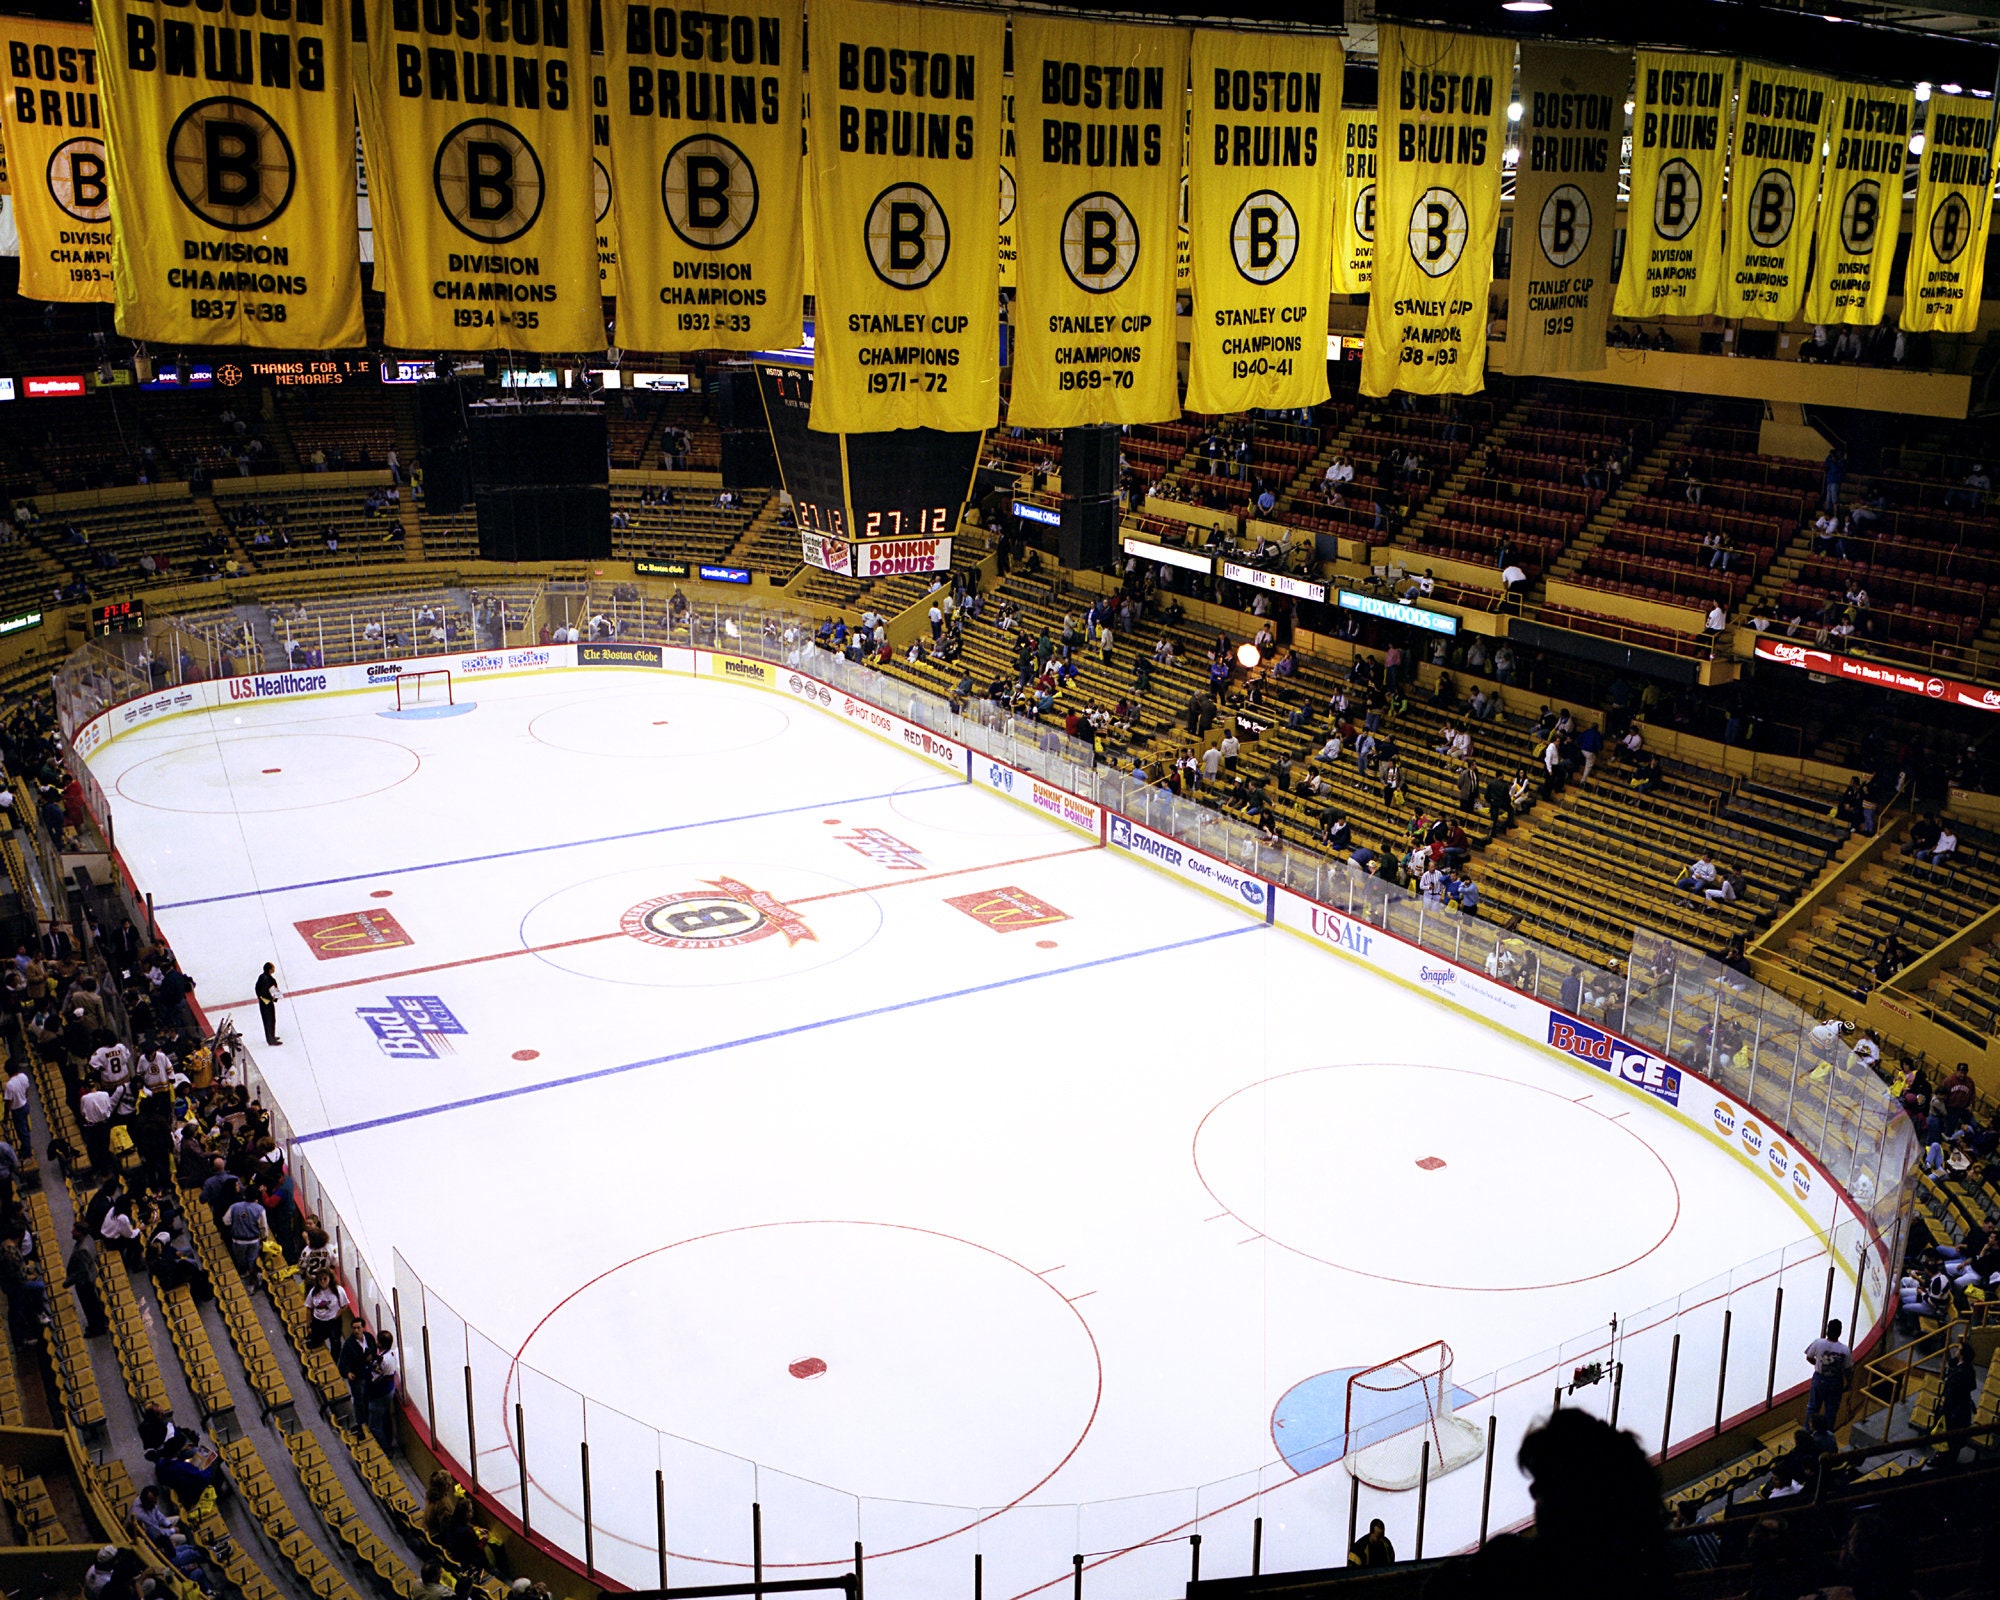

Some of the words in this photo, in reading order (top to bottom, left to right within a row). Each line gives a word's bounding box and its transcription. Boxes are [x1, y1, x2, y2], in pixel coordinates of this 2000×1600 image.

[626, 4, 780, 66] BOSTON
[9, 40, 97, 84] BOST
[126, 13, 325, 92] BRUINS
[396, 43, 569, 111] BRUINS
[839, 42, 975, 100] BOSTON
[628, 66, 779, 124] BRUINS
[1042, 60, 1164, 109] BOSTON
[1214, 68, 1321, 113] BOSTON
[1400, 67, 1493, 116] BOSTON
[1646, 69, 1723, 108] BOSTON
[14, 86, 100, 129] BRUI
[1533, 92, 1613, 131] BOSTON
[1746, 80, 1823, 125] BOSTON
[840, 105, 973, 160] BRUINS
[1043, 119, 1161, 166] BRUINS
[1642, 112, 1718, 151] BRUINS
[1742, 122, 1815, 164] BRUINS
[1214, 126, 1317, 167] BRUINS
[1399, 124, 1488, 166] BRUINS
[1531, 135, 1608, 172] BRUINS
[206, 119, 262, 206] B
[467, 140, 514, 221] B
[686, 155, 730, 228] B
[1663, 173, 1686, 225] B
[1758, 183, 1783, 233] B
[1553, 199, 1576, 252] B
[1851, 194, 1877, 242] B
[890, 202, 926, 270] B
[1084, 211, 1117, 275] B
[1250, 207, 1278, 268] B
[1427, 202, 1450, 261] B
[184, 239, 289, 265] DIVISION
[448, 253, 540, 275] DIVISION
[1651, 250, 1693, 262] DIVISION
[1745, 255, 1784, 269] DIVISION
[167, 268, 307, 295] CHAMPIONS
[673, 261, 752, 280] DIVISION
[1735, 272, 1789, 287] CHAMPIONS
[433, 281, 557, 303] CHAMPIONS
[660, 287, 766, 305] CHAMPIONS
[1573, 278, 1594, 291] CUP
[1215, 308, 1276, 326] STANLEY
[1281, 307, 1307, 322] CUP
[1394, 299, 1446, 316] STANLEY
[848, 314, 925, 333] STANLEY
[931, 316, 969, 334] CUP
[1049, 315, 1116, 333] STANLEY
[1121, 315, 1152, 332] CUP
[1544, 316, 1574, 335] 1929
[858, 347, 960, 366] CHAMPIONS
[1055, 346, 1141, 364] CHAMPIONS
[1222, 337, 1302, 354] CHAMPIONS
[251, 363, 303, 374] THANKS
[311, 363, 337, 372] FOR
[276, 374, 343, 385] MEMORIES
[1059, 370, 1134, 390] 1969-70
[1232, 358, 1293, 379] 1940-41
[866, 508, 947, 537] 27:12
[869, 540, 940, 559] DUNKIN'
[869, 556, 935, 575] DONUTS
[1362, 595, 1431, 627] FOXWOODS
[461, 656, 503, 668] SPORTS
[508, 652, 550, 664] SPORTS
[583, 649, 600, 660] The
[602, 650, 633, 661] Boston
[634, 651, 658, 662] Globe
[366, 664, 402, 675] Gillette
[725, 660, 764, 677] meineke
[255, 674, 327, 698] Healthcare
[856, 706, 869, 721] HOT
[871, 713, 891, 732] DOGS
[904, 729, 921, 746] RED
[932, 743, 953, 761] DOG
[1033, 783, 1063, 803] DUNKIN'
[1033, 793, 1061, 814] DONUTS
[1064, 797, 1095, 819] DUNKIN'
[1064, 807, 1094, 829] DONUTS
[1132, 832, 1182, 867] STARTER
[1216, 870, 1240, 890] WAVE
[674, 937, 750, 950] THANKS
[1310, 907, 1373, 957] USAir
[1420, 965, 1455, 985] Snapple
[110, 1057, 121, 1073] 8
[1551, 1022, 1615, 1062] Bud
[1610, 1049, 1667, 1088] ICE
[1713, 1108, 1735, 1130] Gulf
[1741, 1128, 1763, 1150] Gulf
[1768, 1148, 1788, 1171] Gulf
[1792, 1169, 1811, 1193] Gulf
